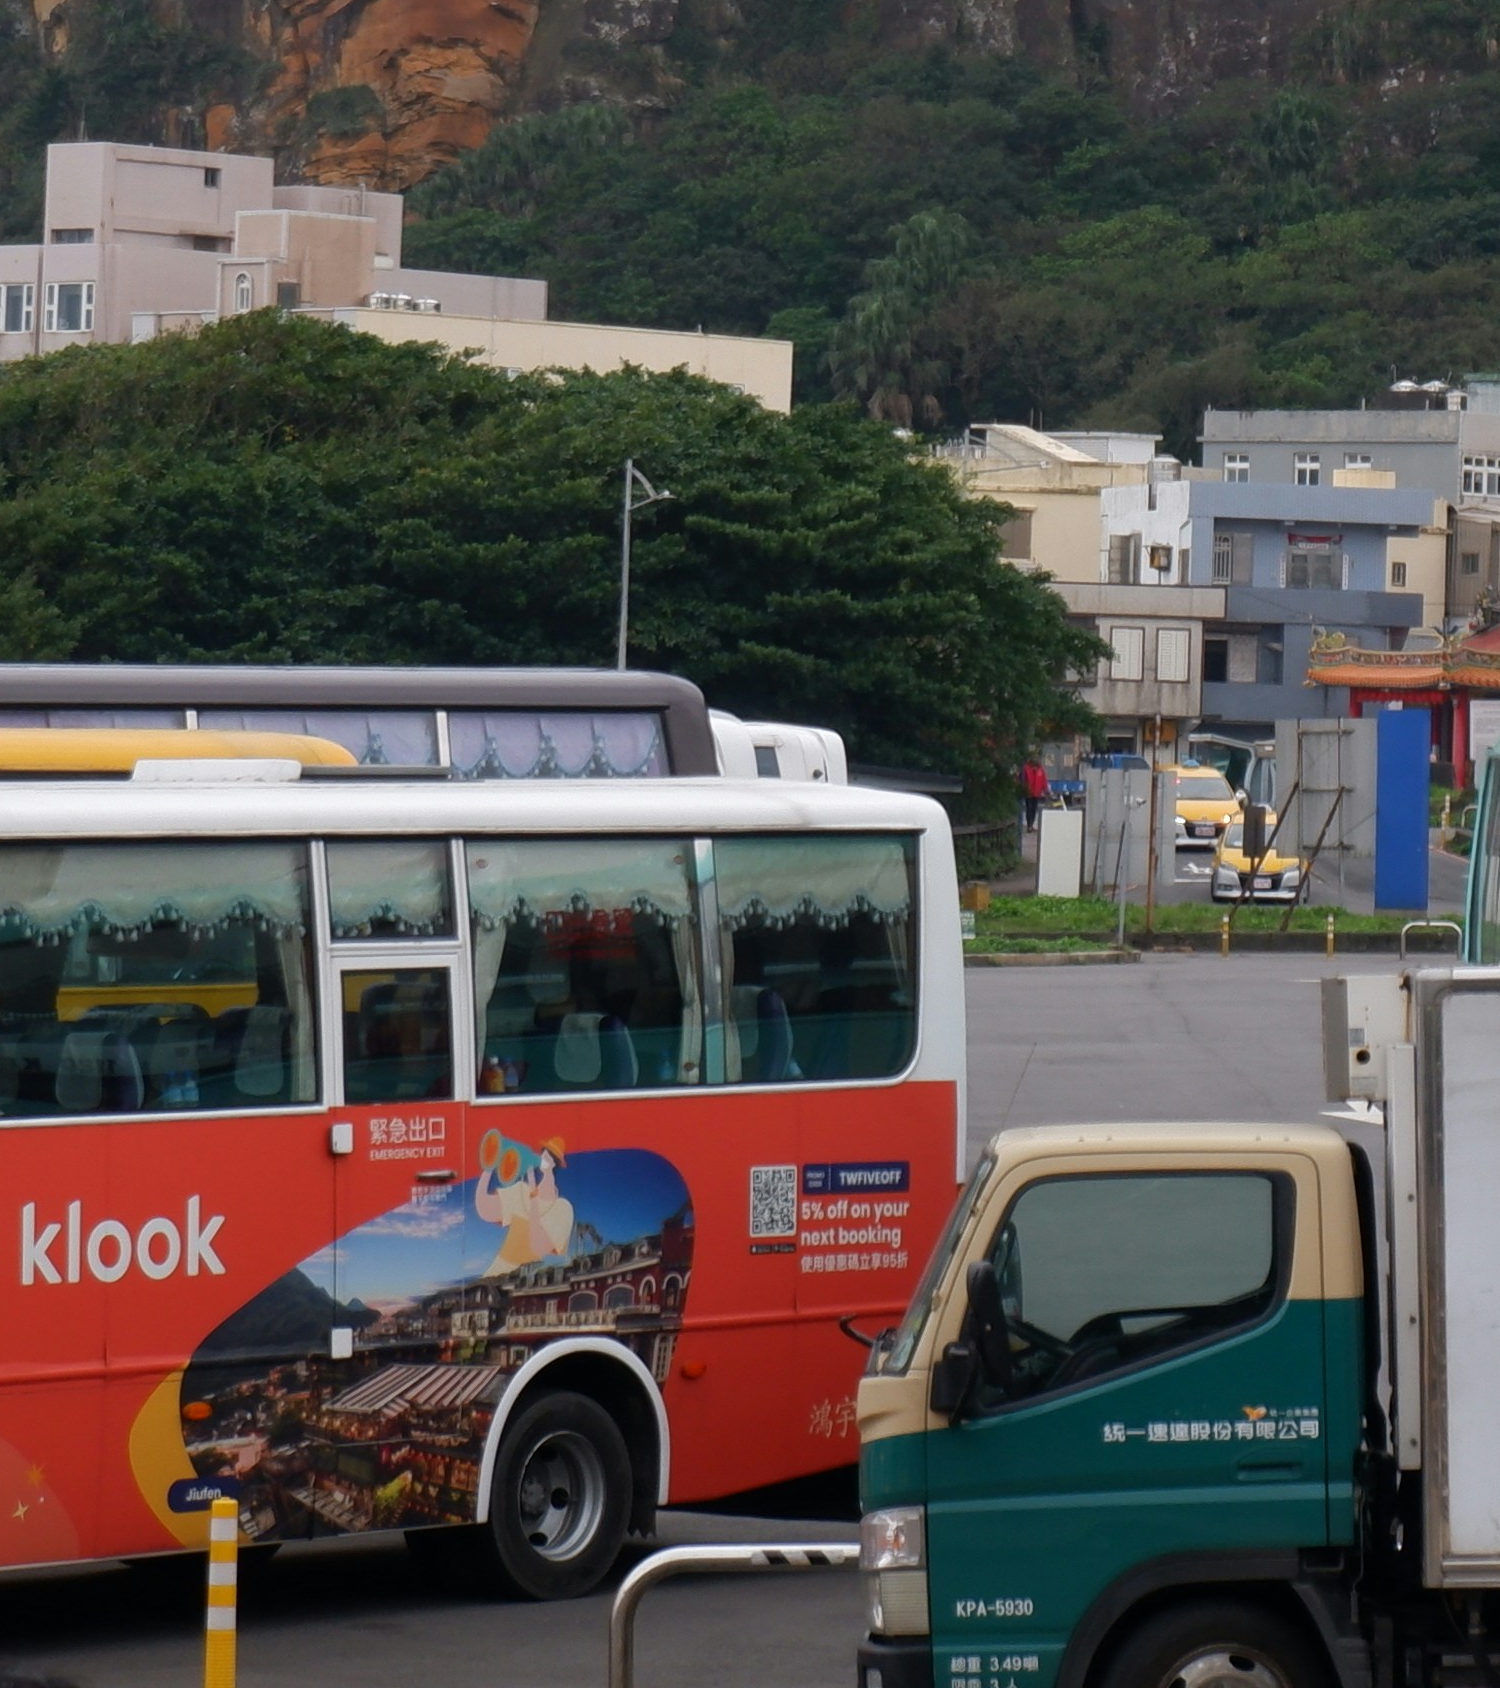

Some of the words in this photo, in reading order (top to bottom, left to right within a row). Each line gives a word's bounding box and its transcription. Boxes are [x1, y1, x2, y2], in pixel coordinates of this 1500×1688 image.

[370, 1116, 445, 1145] 緊急出口
[370, 1148, 425, 1161] EMERGENCY
[426, 1146, 445, 1158] EXIT
[839, 1170, 901, 1186] TWFIVEOFF
[802, 1202, 824, 1220] 5%
[828, 1200, 848, 1218] off
[851, 1203, 870, 1218] on
[874, 1201, 909, 1223] your
[21, 1194, 226, 1286] klook
[801, 1228, 835, 1246] next
[838, 1224, 901, 1248] booking
[1103, 1420, 1319, 1442] 統一速達股份有限公司
[185, 1486, 222, 1502] Jiufen
[956, 1599, 1034, 1617] KPA-5930
[950, 1656, 981, 1673] 總重
